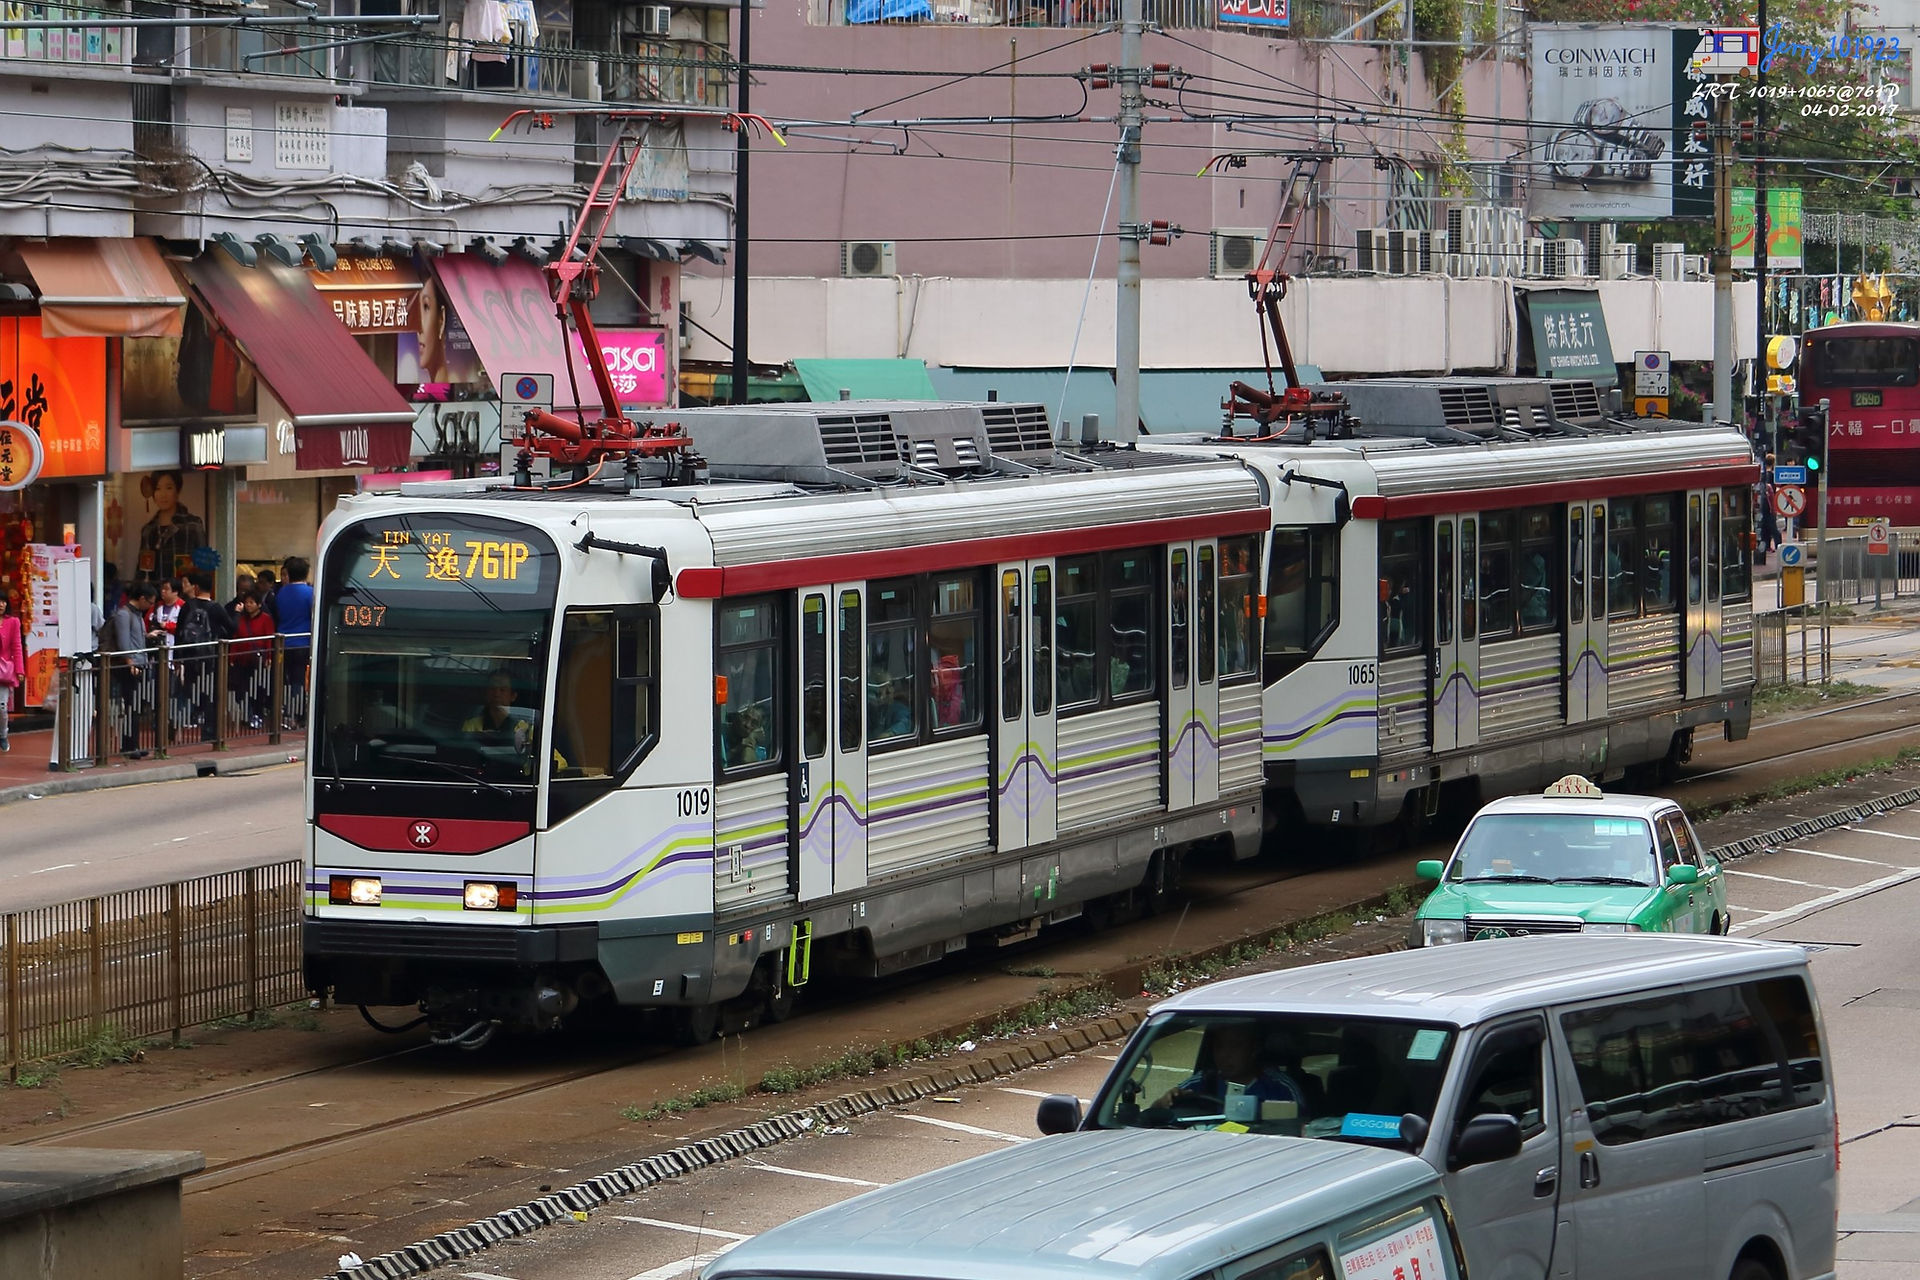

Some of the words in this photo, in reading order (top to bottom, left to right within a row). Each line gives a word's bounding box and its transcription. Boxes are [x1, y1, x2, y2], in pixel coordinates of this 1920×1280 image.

[1545, 48, 1656, 64] COINWATCH
[1558, 66, 1643, 78] 瑞士科因沃奇
[1656, 373, 1663, 382] 7
[1657, 386, 1667, 395] 12
[1855, 392, 1880, 406] 269D
[1830, 420, 1863, 436] 大福
[191, 429, 225, 465] wanko
[339, 427, 369, 461] wanko
[383, 531, 410, 544] TIN
[422, 532, 451, 545] YAT
[465, 541, 529, 580] 761P
[344, 606, 387, 627] 097
[1348, 664, 1375, 685] 1065
[1556, 784, 1590, 794] TAXI
[677, 788, 710, 817] 1019
[1485, 928, 1503, 936] TAXI
